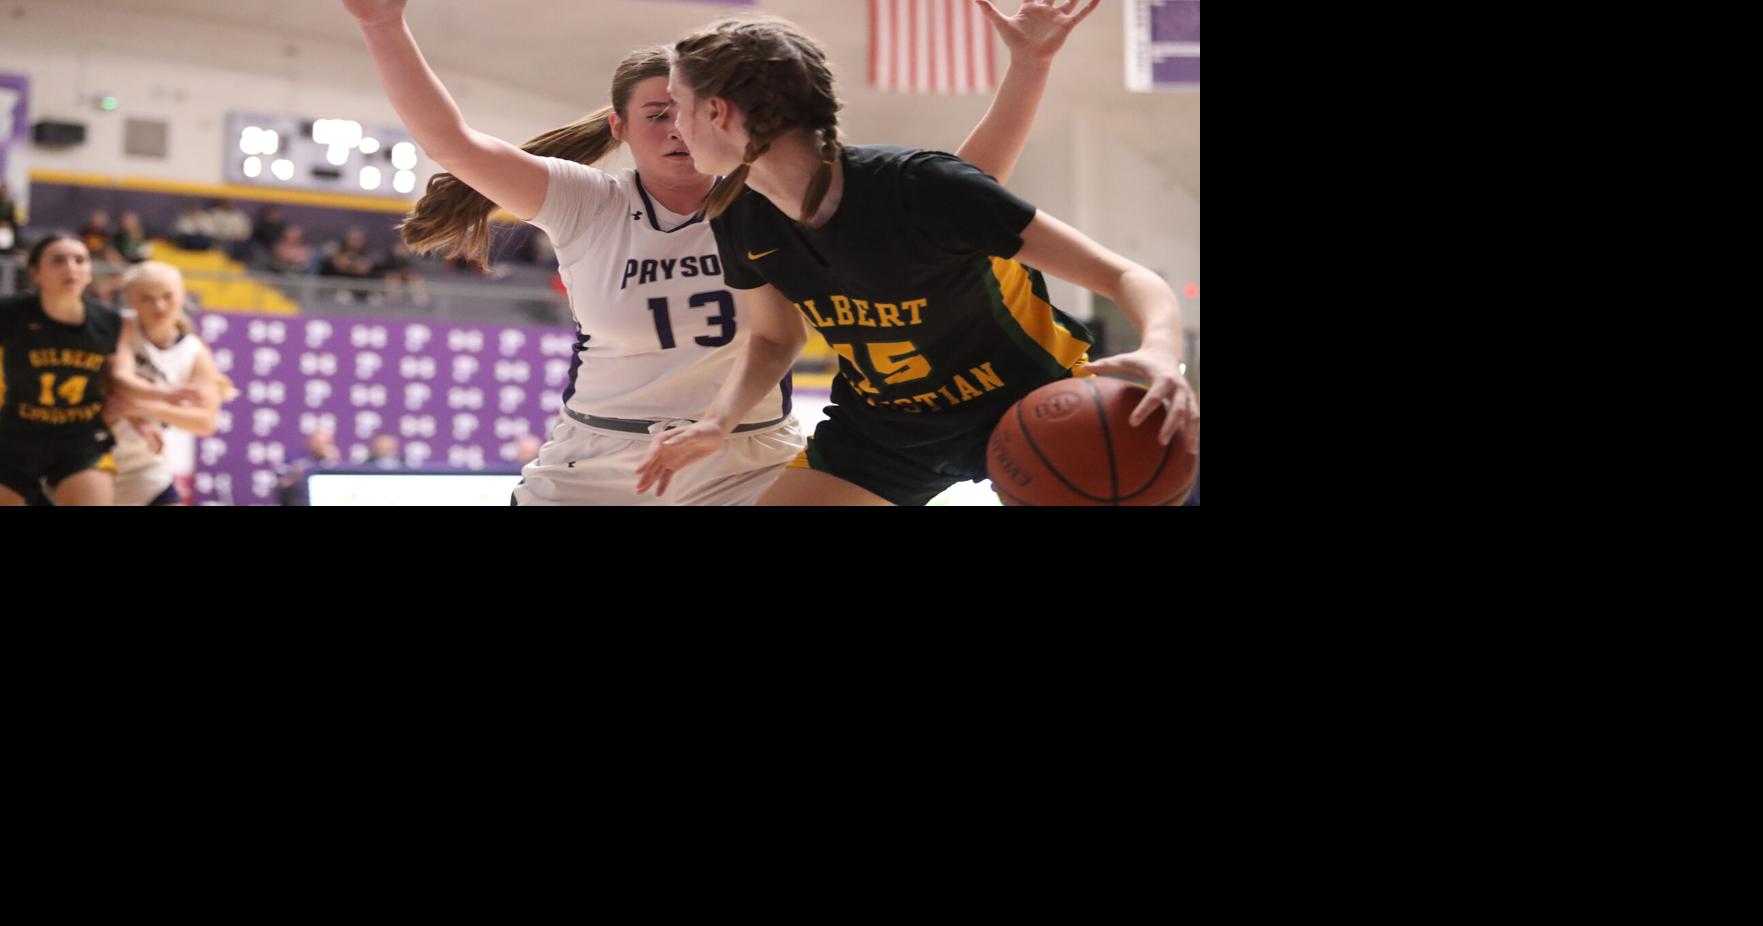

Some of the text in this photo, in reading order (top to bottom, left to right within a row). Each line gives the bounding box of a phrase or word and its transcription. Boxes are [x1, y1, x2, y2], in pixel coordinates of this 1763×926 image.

[621, 254, 721, 289] PAYSO
[647, 290, 736, 349] 13
[793, 295, 927, 327] LBERT
[38, 373, 88, 405] 14
[865, 362, 1005, 414] STIAN
